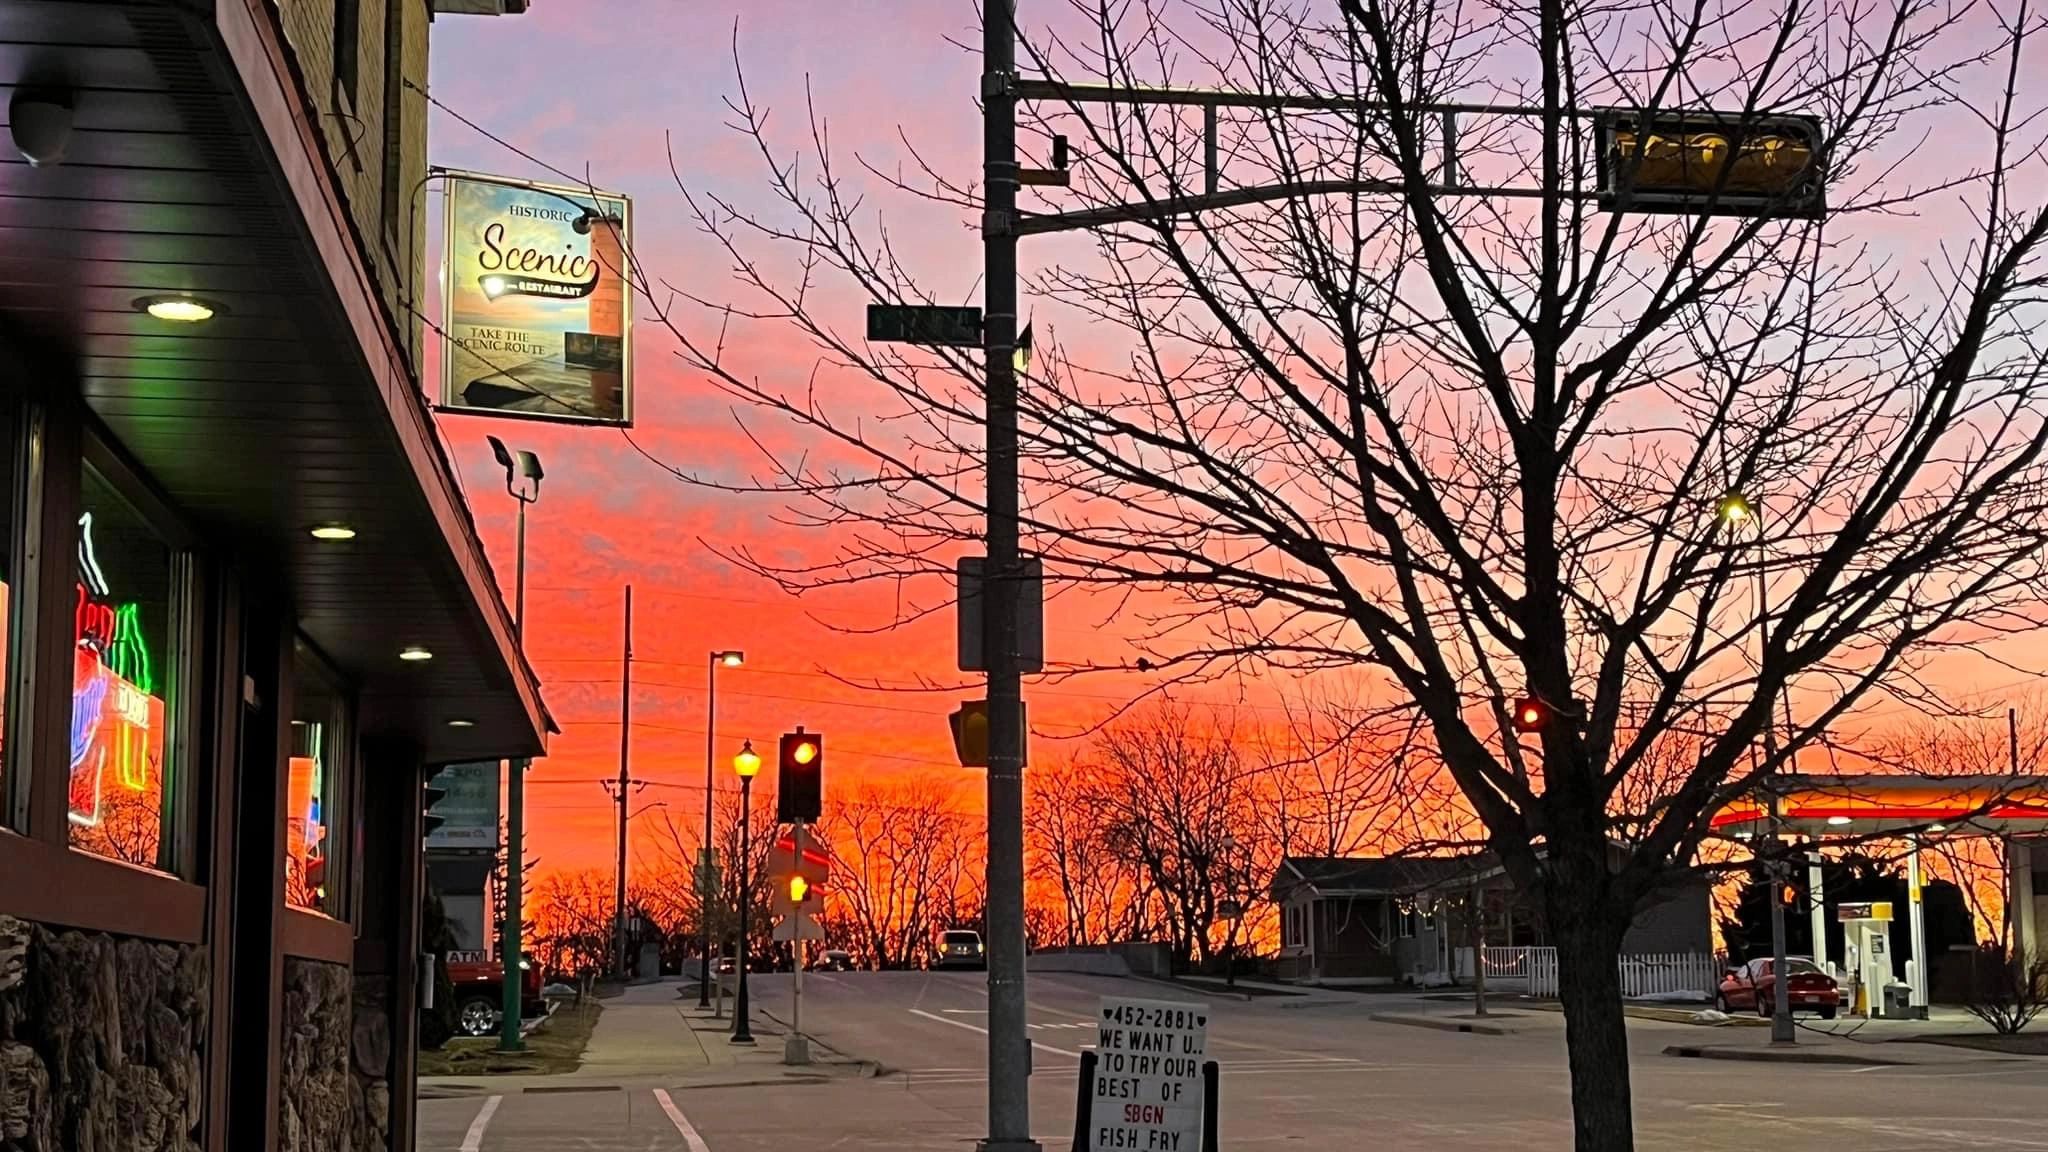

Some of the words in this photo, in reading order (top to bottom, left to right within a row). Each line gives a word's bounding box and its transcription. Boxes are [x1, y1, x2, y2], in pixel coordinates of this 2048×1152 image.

[509, 205, 573, 222] HISTORIC
[478, 223, 599, 280] Scenic
[518, 281, 582, 297] RESTAURANT
[470, 327, 502, 340] TAKE
[506, 329, 529, 343] THE
[456, 338, 504, 352] SCENIC
[504, 340, 545, 355] ROUTE
[449, 951, 483, 963] ATM
[1114, 1006, 1194, 1030] 452-2881
[1100, 1029, 1123, 1048] WE
[1129, 1031, 1174, 1053] WANT
[1104, 1053, 1124, 1073] TO
[1130, 1055, 1160, 1075] TRY
[1164, 1058, 1196, 1078] OUR
[1098, 1077, 1140, 1098] BEST
[1161, 1082, 1182, 1102] OF
[1124, 1104, 1164, 1124] SBGN
[1100, 1128, 1138, 1148] FISH
[1149, 1130, 1180, 1151] FRY
